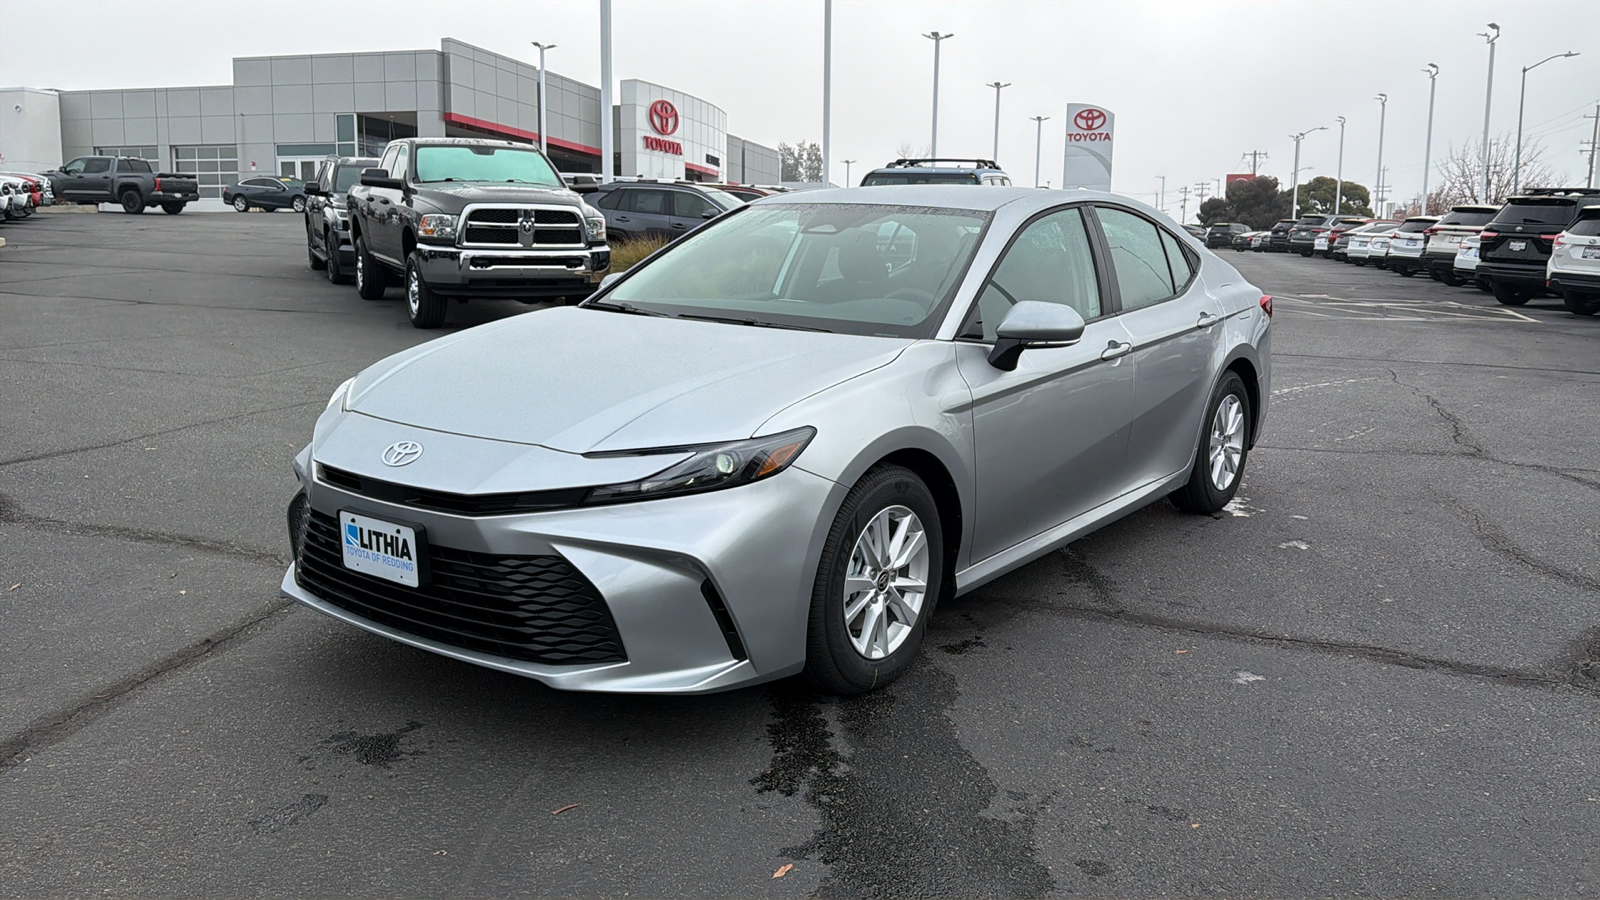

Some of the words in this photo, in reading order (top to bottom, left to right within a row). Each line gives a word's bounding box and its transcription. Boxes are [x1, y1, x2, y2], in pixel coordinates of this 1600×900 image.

[643, 135, 683, 156] TOYOTA
[1067, 132, 1112, 142] TOYOTA
[359, 526, 413, 562] LITHIA
[346, 545, 371, 560] TOYOTA
[371, 552, 380, 562] OF
[382, 555, 414, 572] REDDING
